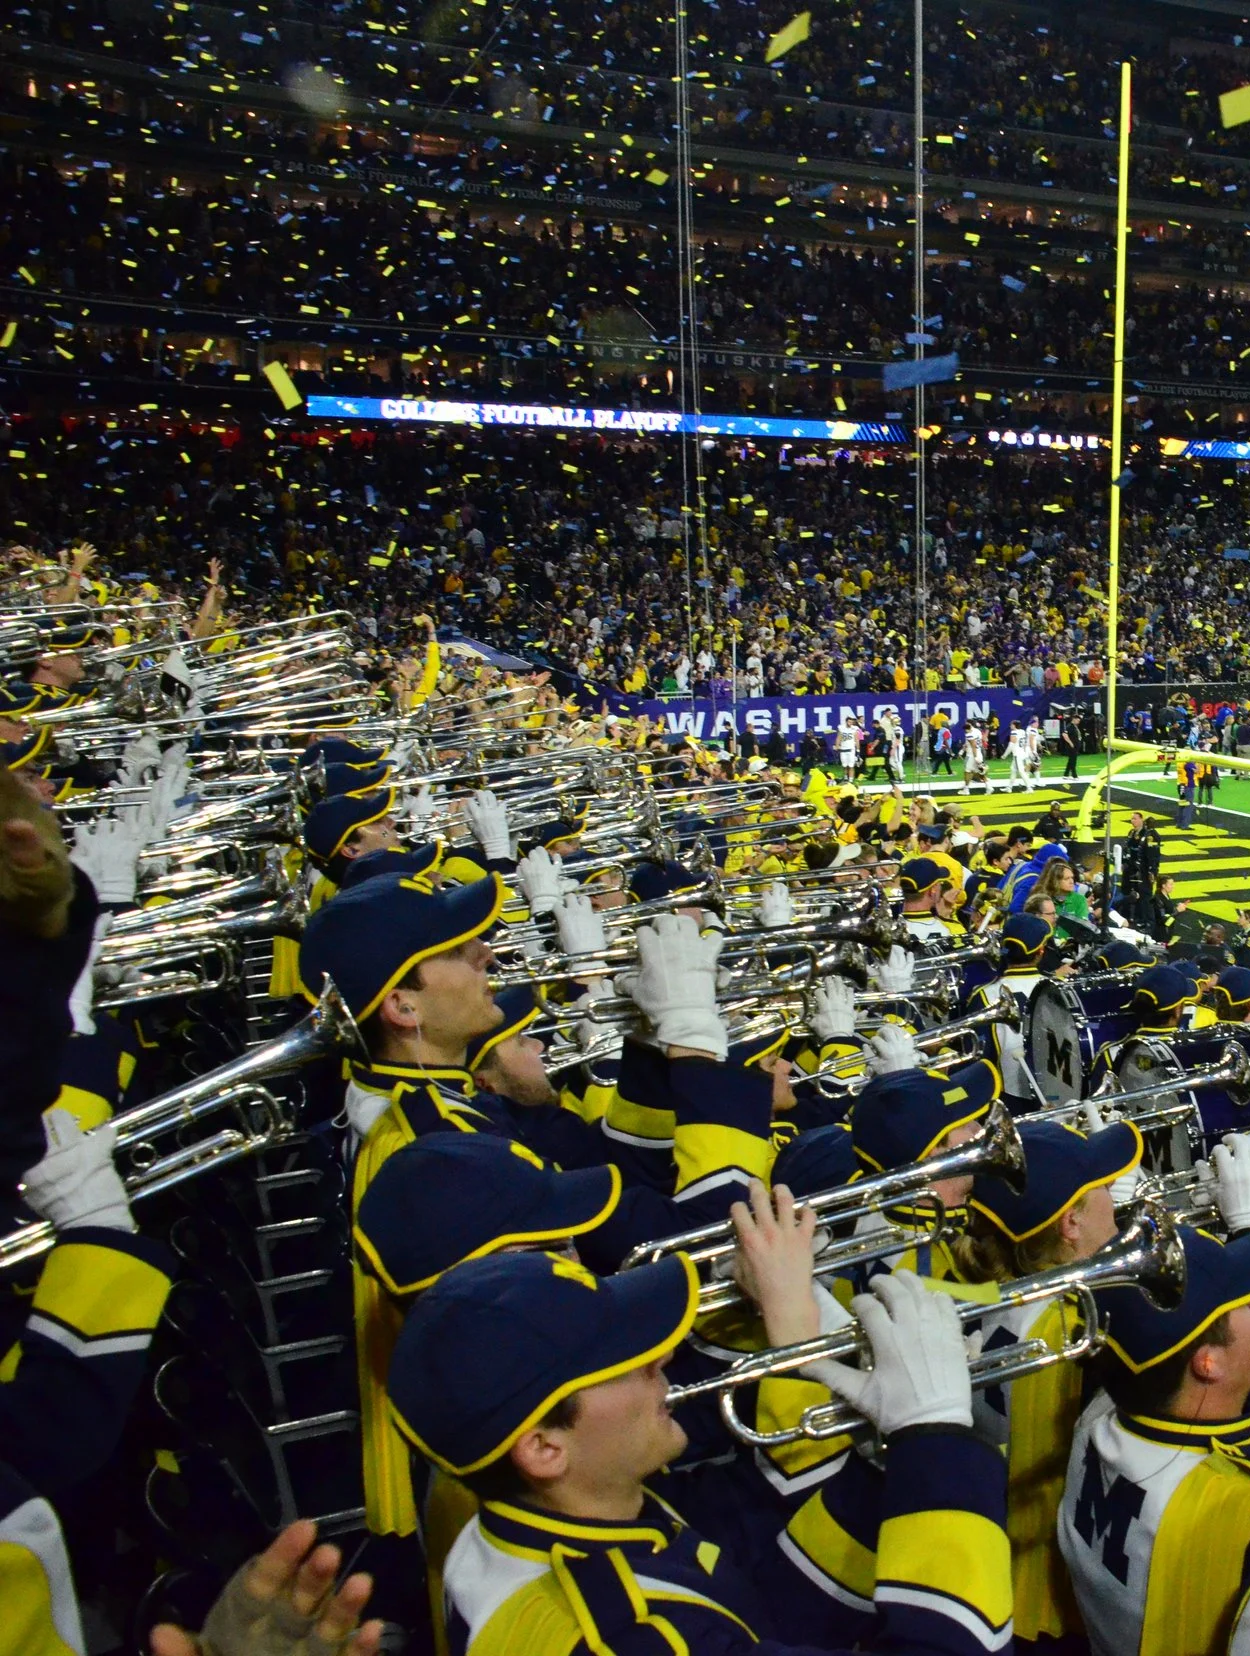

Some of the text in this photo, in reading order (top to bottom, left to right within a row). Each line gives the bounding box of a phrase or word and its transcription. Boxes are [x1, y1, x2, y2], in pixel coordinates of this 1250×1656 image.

[273, 159, 304, 172] 224
[306, 163, 365, 180] COLGE
[368, 171, 435, 188] FOOTBALL
[437, 178, 490, 195] PYOFF
[493, 338, 680, 361] WSHNGTN
[381, 399, 682, 431] COLLE FOOTBALL PLAYOFF
[666, 701, 990, 737] WASHINGTON
[1046, 1027, 1074, 1089] M
[1074, 1440, 1147, 1587] M
